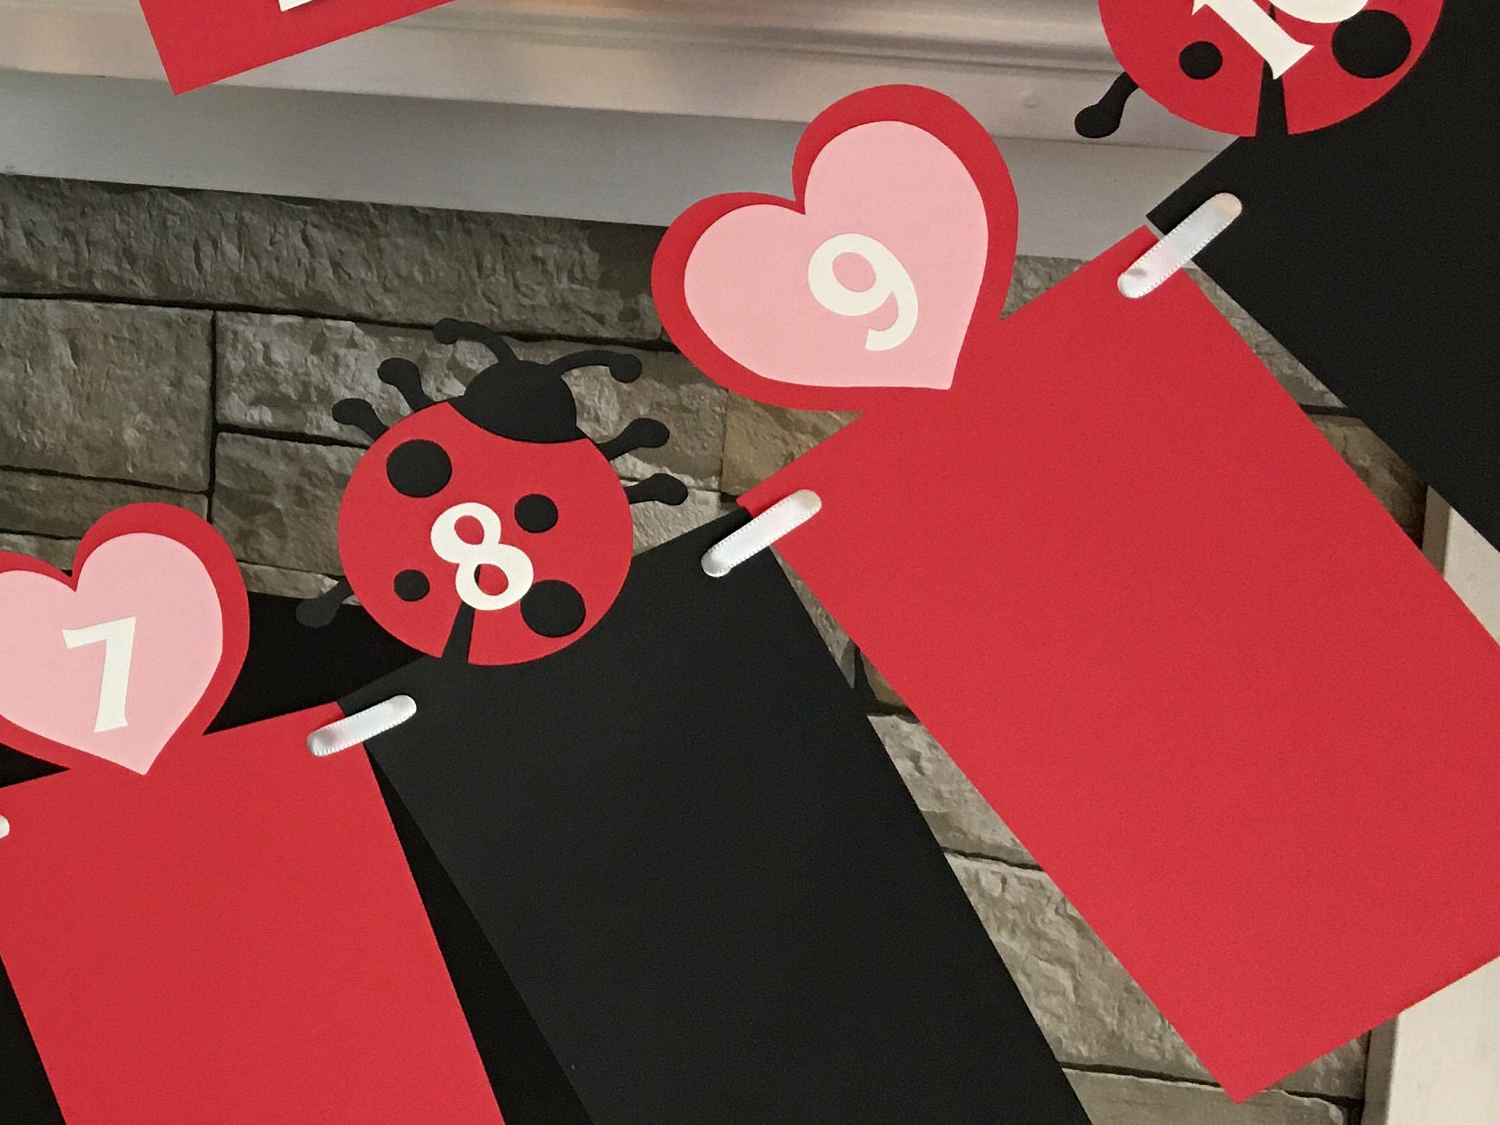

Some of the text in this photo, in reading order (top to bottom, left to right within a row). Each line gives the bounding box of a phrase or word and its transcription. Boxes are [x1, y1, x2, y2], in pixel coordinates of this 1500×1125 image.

[807, 233, 919, 352] 9
[430, 502, 534, 611] 8
[61, 616, 137, 733] 7
